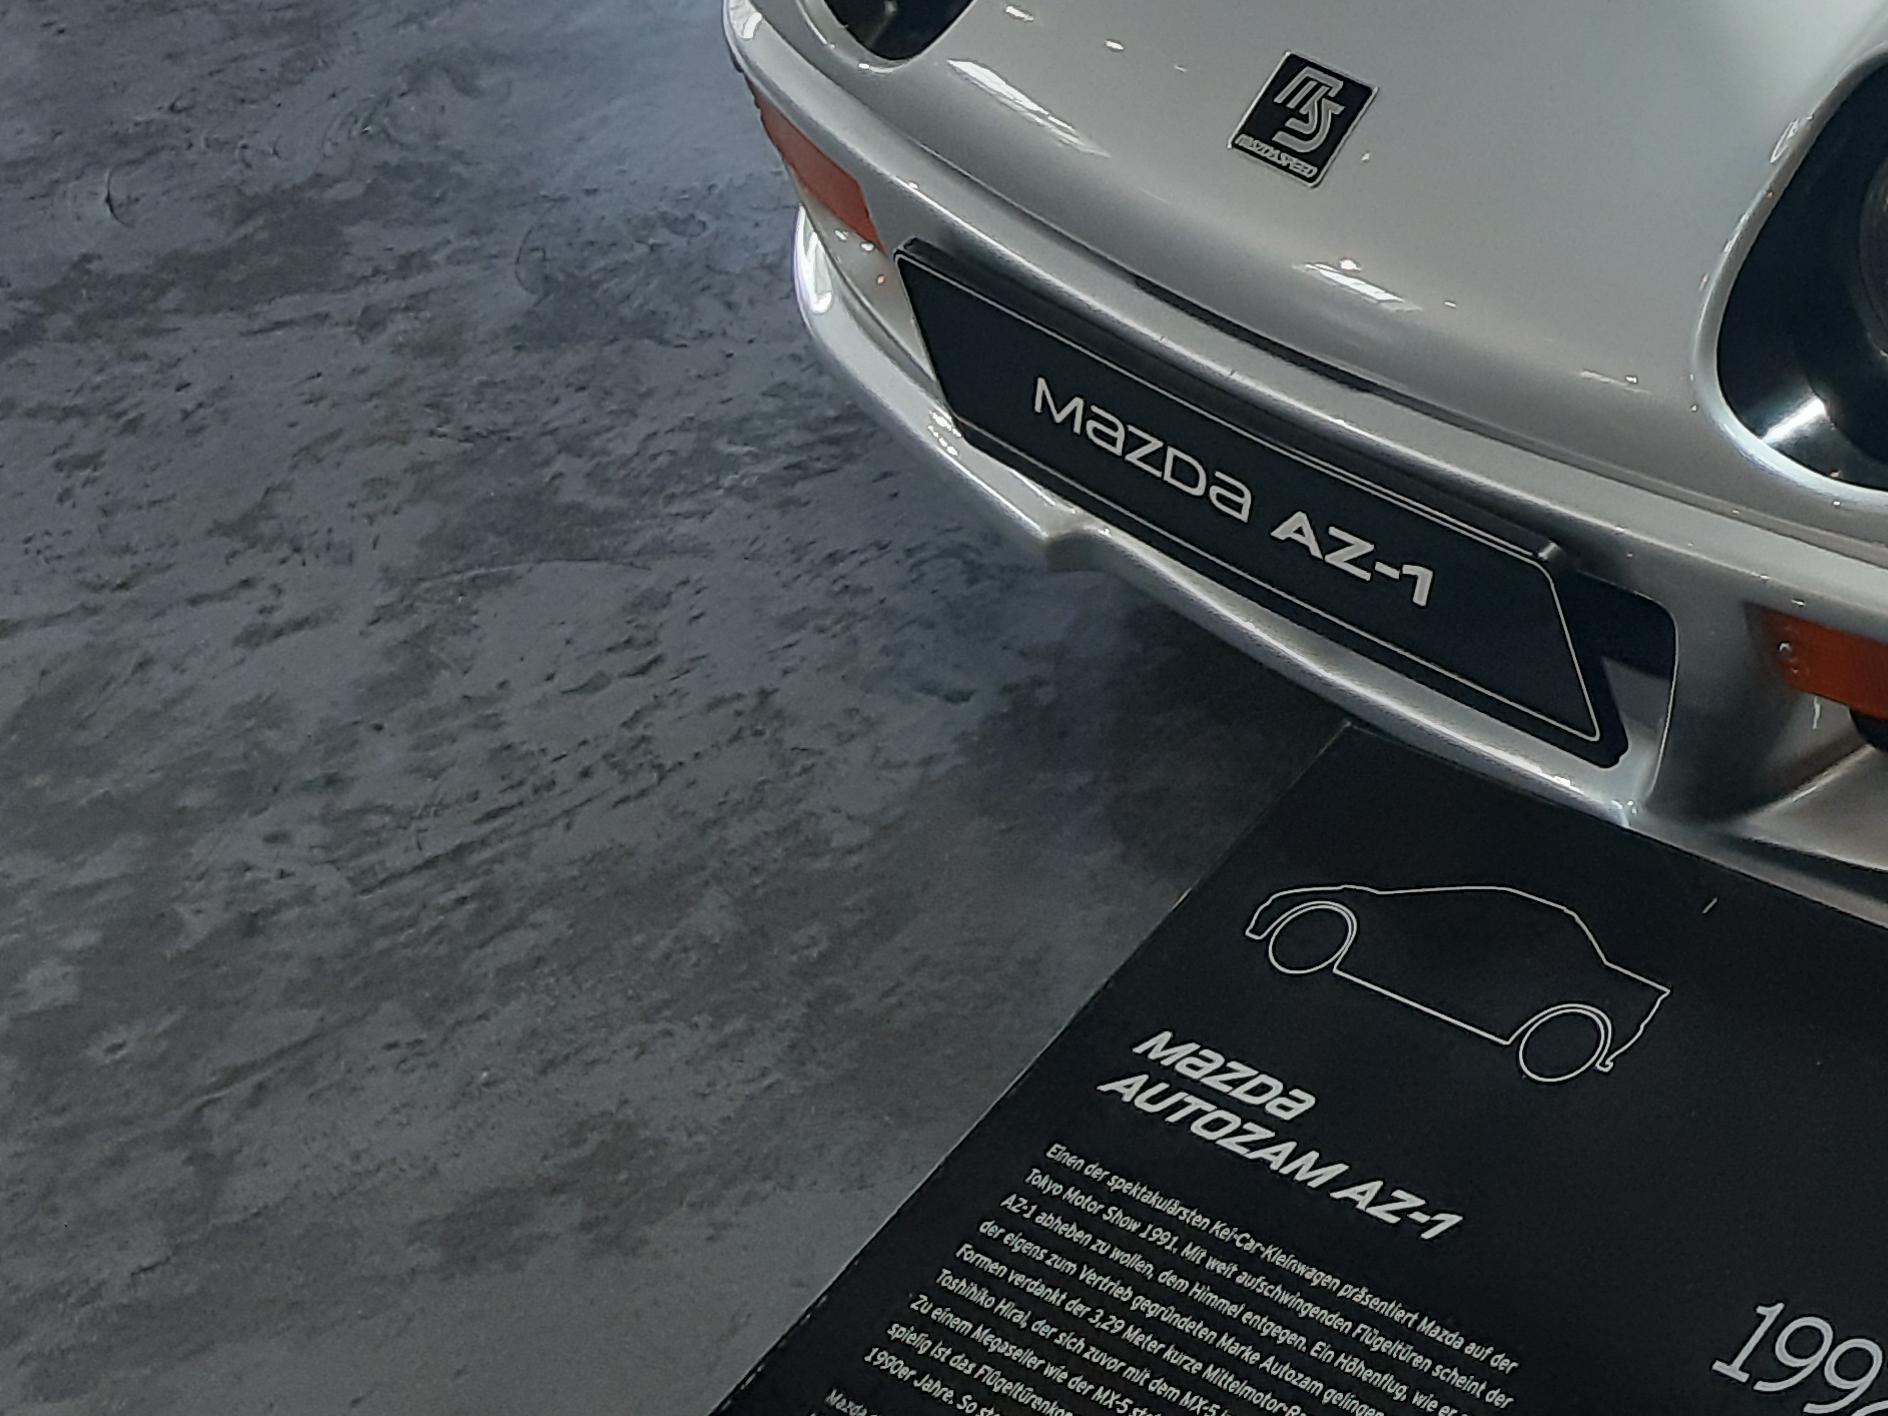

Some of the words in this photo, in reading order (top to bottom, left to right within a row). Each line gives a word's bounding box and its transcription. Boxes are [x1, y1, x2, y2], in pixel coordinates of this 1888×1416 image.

[1270, 511, 1433, 606] AZ-1
[1096, 1074, 1349, 1188] AUTOZAM
[1329, 1180, 1463, 1240] AZ-1
[955, 1243, 1008, 1278] Formen
[1007, 1269, 1068, 1307] verdankt
[1064, 1298, 1092, 1318] der
[1087, 1308, 1126, 1334] 3,29
[1121, 1324, 1166, 1354] Meter
[1162, 1344, 1203, 1374] kurze
[979, 1220, 1006, 1239] der
[1003, 1232, 1048, 1261] eigens
[1044, 1253, 1077, 1276] zum
[1078, 1264, 1134, 1302] Vertrieb
[1130, 1295, 1218, 1345] gegründeten
[1215, 1332, 1261, 1365] Marke
[1258, 1355, 1324, 1396] Autozam
[1000, 1193, 1038, 1219] AZ-1
[1035, 1212, 1093, 1247] abheben
[1089, 1239, 1111, 1255] zu
[1108, 1247, 1154, 1280] wollen,
[1157, 1269, 1190, 1293] dem
[1188, 1282, 1246, 1319] Himmel
[1241, 1311, 1307, 1352] entgegen.
[1309, 1341, 1335, 1363] Ein
[1333, 1352, 1408, 1402] Höhenflug,
[1411, 1391, 1439, 1412] wie
[1025, 1168, 1064, 1196] Tokyo
[1062, 1186, 1105, 1214] Motor
[1102, 1206, 1142, 1232] Show
[1180, 1241, 1207, 1265] Mit
[1205, 1256, 1238, 1279] weit
[1235, 1271, 1353, 1334] aufschwingenden
[1351, 1323, 1433, 1372] Flügeltüren
[1431, 1364, 1487, 1398] scheint
[1485, 1388, 1514, 1409] der
[1046, 1143, 1085, 1171] Einen
[1083, 1162, 1111, 1182] der
[1106, 1175, 1211, 1231] spektakulärsten
[1208, 1220, 1341, 1292] Kei-Car-Kleinwagen
[1336, 1283, 1420, 1328] präsentiert
[1416, 1316, 1465, 1350] Mazda
[1464, 1342, 1494, 1361] auf
[1490, 1352, 1519, 1374] der
[864, 1347, 917, 1381] 1990er
[913, 1374, 954, 1405] Jahre.
[956, 1394, 978, 1414] So
[910, 1294, 933, 1314] Zu
[930, 1307, 973, 1336] einem
[970, 1324, 1046, 1370] Megaseller
[1043, 1362, 1068, 1383] wie
[1067, 1375, 1095, 1395] der
[1091, 1385, 1134, 1414] MX-5
[929, 1340, 953, 1362] ist
[948, 1353, 977, 1375] das
[936, 1268, 996, 1309] Toshihiko
[1031, 1319, 1058, 1339] der
[1053, 1331, 1085, 1354] sich
[1082, 1345, 1127, 1373] zuvor
[1122, 1366, 1151, 1386] mit
[1148, 1377, 1181, 1402] dem
